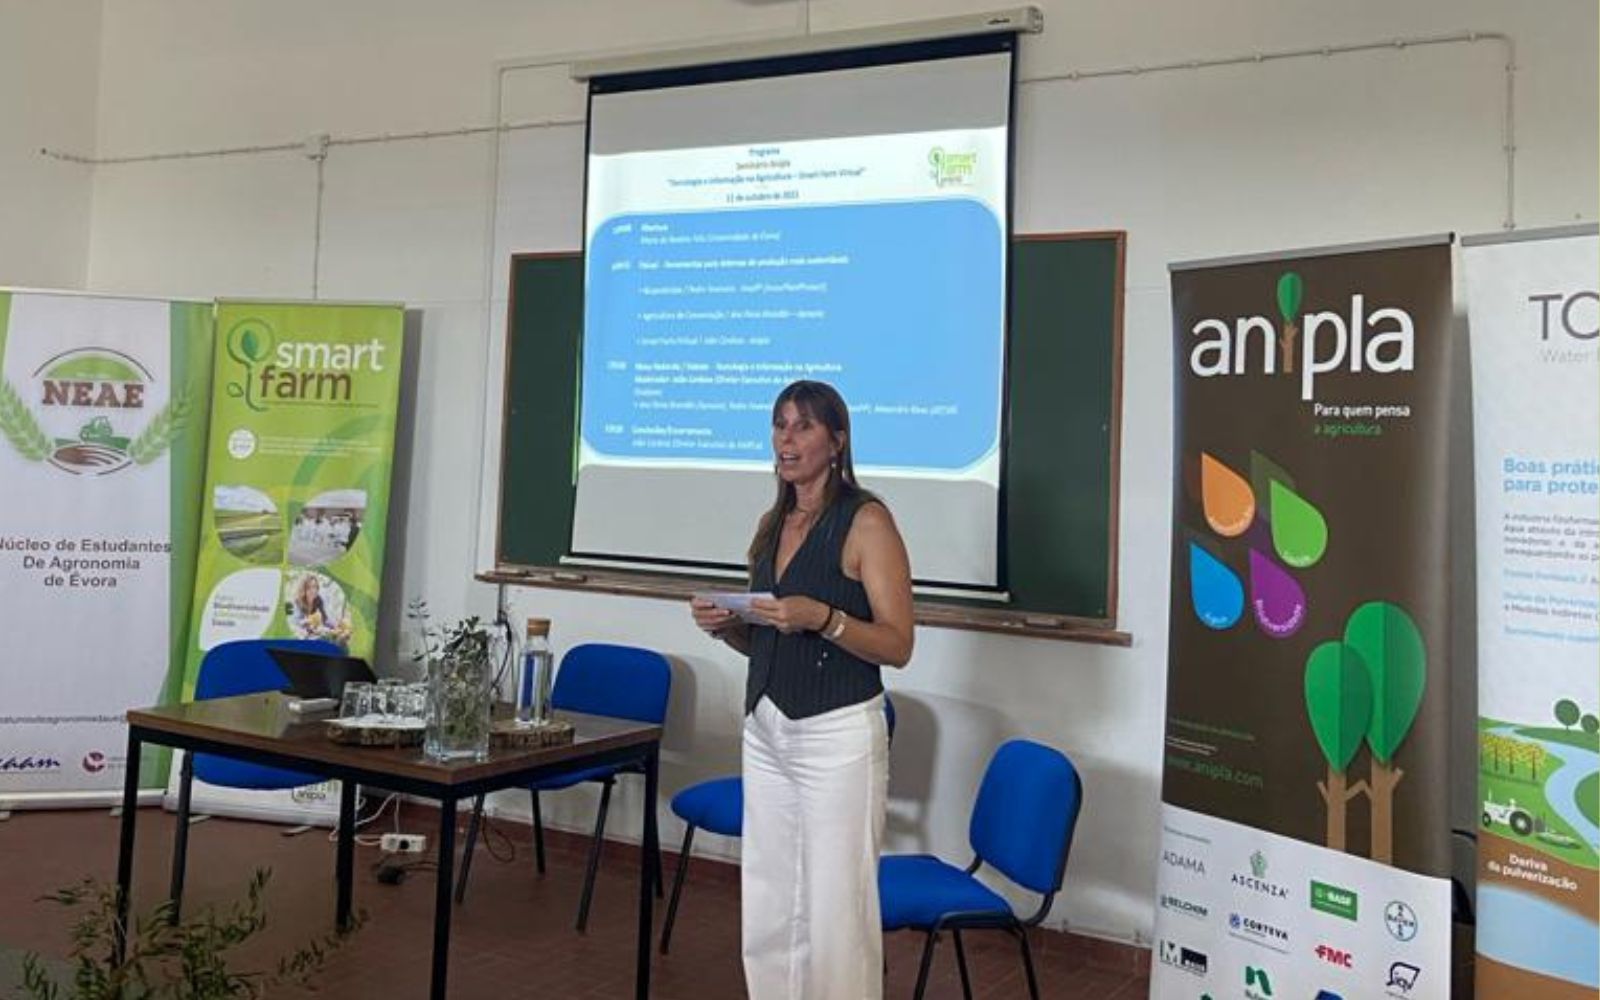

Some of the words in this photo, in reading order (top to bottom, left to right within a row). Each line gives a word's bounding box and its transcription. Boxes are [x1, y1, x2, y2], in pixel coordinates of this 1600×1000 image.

[1190, 272, 1415, 401] anipla
[276, 338, 386, 372] smart
[42, 379, 145, 409] NEAE
[259, 365, 352, 401] farm
[1314, 402, 1340, 417] Para
[1342, 404, 1373, 419] quem
[1375, 403, 1411, 419] pensa
[1322, 422, 1382, 438] agricultura
[1503, 457, 1547, 474] Boas
[1503, 479, 1542, 493] para
[55, 538, 76, 552] de
[80, 538, 172, 553] Estudantes
[23, 555, 46, 569] De
[49, 555, 141, 572] Agronomia
[44, 574, 66, 588] de
[69, 572, 118, 588] Évora
[1162, 850, 1206, 875] ADAMA
[1508, 852, 1549, 872] Deriva
[1230, 874, 1288, 899] ASCENZA
[1502, 865, 1578, 891] pulverização
[1243, 918, 1289, 941] CORTEVA
[1314, 944, 1352, 969] FMC
